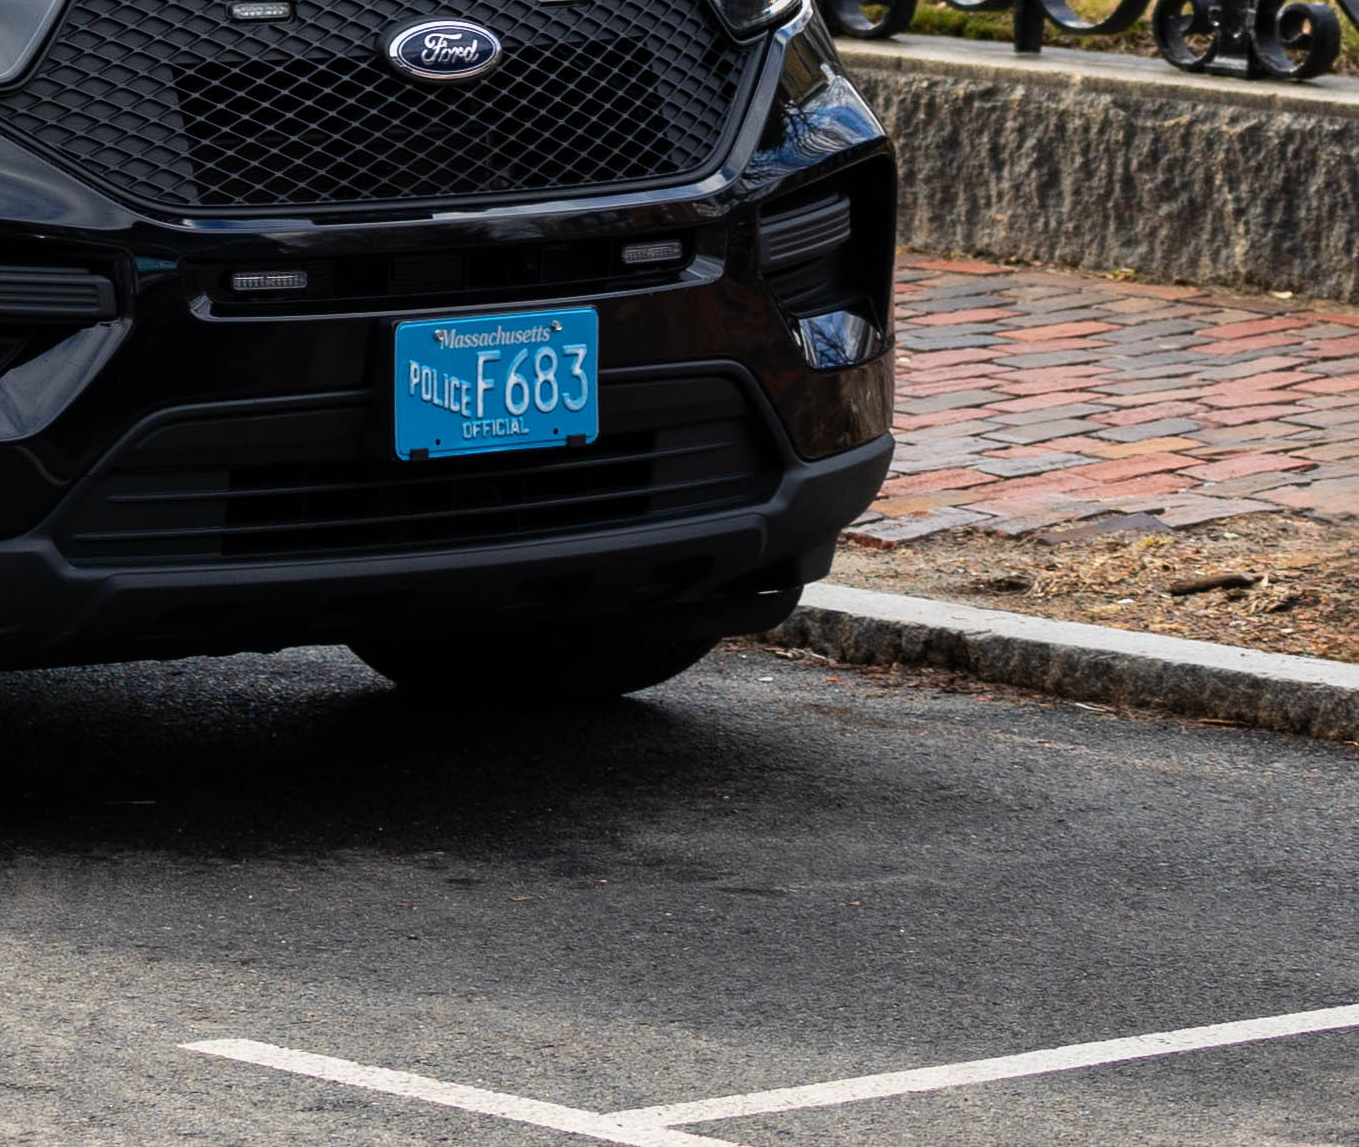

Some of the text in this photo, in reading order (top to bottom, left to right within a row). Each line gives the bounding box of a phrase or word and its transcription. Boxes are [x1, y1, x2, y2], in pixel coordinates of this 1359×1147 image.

[420, 32, 480, 65] Ford
[439, 325, 551, 350] Massachusetts
[408, 343, 589, 420] POLICE F683
[462, 416, 531, 440] OFFICIAL
